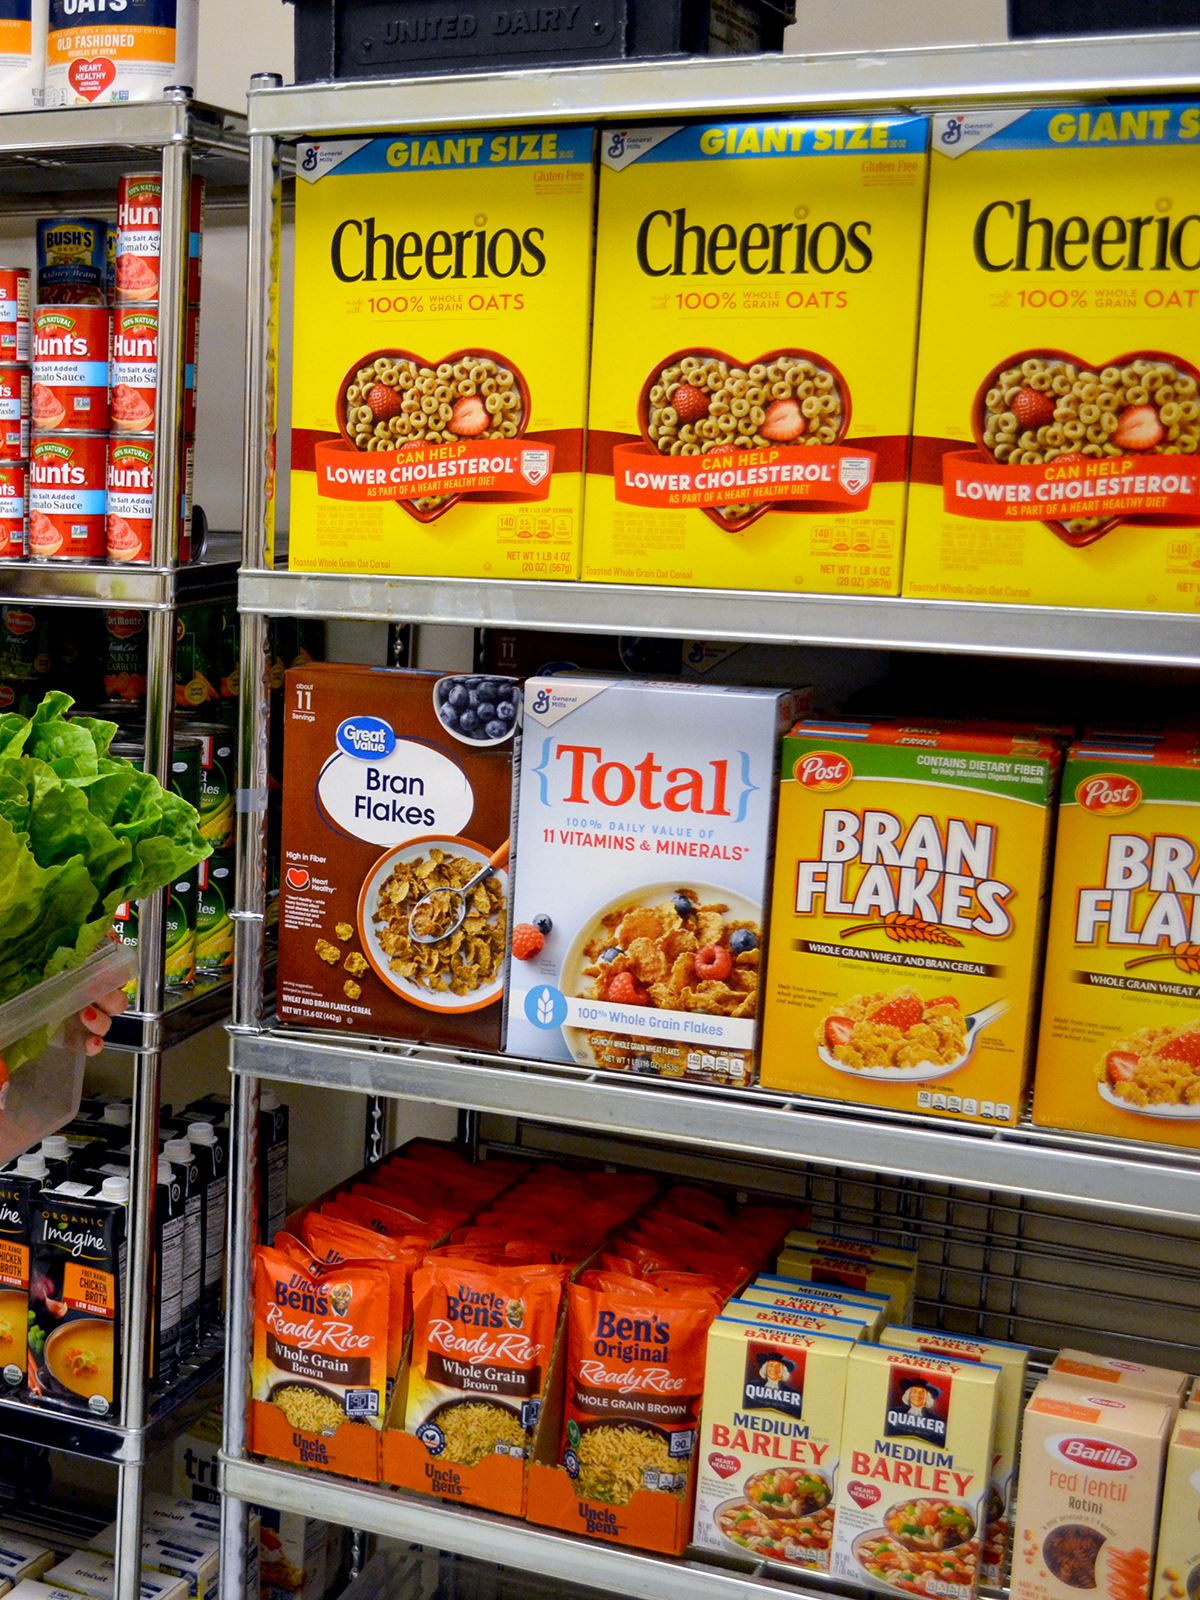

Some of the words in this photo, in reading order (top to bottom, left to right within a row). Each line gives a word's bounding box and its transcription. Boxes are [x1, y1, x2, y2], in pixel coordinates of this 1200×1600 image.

[382, 14, 478, 45] UNITED
[492, 5, 581, 35] DAIRY
[57, 39, 72, 51] OLD
[75, 34, 135, 48] FASHIONED
[75, 72, 106, 81] HEALTHY
[78, 64, 102, 72] HEART
[1048, 110, 1171, 143] GIANT
[700, 127, 808, 155] GIANT
[813, 122, 889, 150] SIZE
[386, 139, 483, 168] GIANT
[490, 134, 557, 162] SIZE
[533, 171, 563, 182] Gluten
[566, 170, 584, 181] Free
[47, 231, 91, 248] BUSH'S
[637, 205, 873, 277] Cheerios
[973, 198, 1200, 272] Cheerio
[331, 214, 546, 283] Cheerios
[676, 293, 736, 310] 100%
[743, 292, 780, 300] WHOLE
[743, 300, 780, 309] GRAIN
[786, 291, 848, 309] OATS
[1018, 290, 1088, 308] 100%
[1095, 299, 1136, 307] GRAIN
[1144, 289, 1200, 308] OAT
[55, 373, 85, 381] Sauce
[326, 466, 386, 484] LOWER
[390, 458, 514, 482] CHOLESTEROL
[702, 456, 733, 471] CAN
[738, 451, 779, 466] HELP
[1044, 467, 1080, 481] CAN
[1085, 461, 1133, 476] HELP
[367, 488, 376, 497] AS
[379, 486, 397, 496] PART
[399, 484, 409, 494] OF
[410, 484, 416, 493] A
[418, 481, 442, 492] HEART
[444, 478, 476, 490] HEALTHY
[478, 476, 495, 486] DIET
[625, 471, 690, 491] LOWER
[694, 465, 831, 489] CHOLESTEROL
[956, 480, 1031, 502] LOWER
[1036, 476, 1192, 501] CHOLESTEROL
[54, 502, 83, 510] Sauce
[297, 690, 312, 710] 11
[344, 725, 386, 742] Great
[353, 740, 386, 753] Value
[802, 757, 844, 781] Post
[917, 755, 967, 769] CONTAINS
[969, 760, 1012, 773] DIETARY
[1014, 764, 1044, 776] FIBER
[366, 768, 425, 796] Bran
[556, 744, 731, 816] Total
[1085, 781, 1132, 805] Post
[355, 795, 435, 827] Flakes
[566, 817, 602, 829] 100%
[609, 821, 645, 833] DAILY
[652, 826, 692, 837] VALUE
[700, 830, 714, 839] OF
[544, 829, 554, 843] 11
[560, 831, 634, 851] VITAMINS
[640, 840, 651, 851] &
[656, 840, 742, 860] MINERALS
[822, 810, 993, 879] BRAN
[286, 851, 301, 862] High
[310, 854, 326, 864] Fiber
[312, 877, 328, 886] Heart
[796, 861, 1014, 935] FLAKES
[808, 943, 839, 956] WHOLE
[841, 947, 867, 959] GRAIN
[869, 950, 903, 963] WHEAT
[905, 955, 924, 965] AND
[925, 957, 951, 969] BRAN
[952, 961, 985, 974] CEREAL
[1089, 974, 1124, 988] WHOLE
[1127, 978, 1157, 992] GRAIN
[1159, 982, 1194, 996] WHEAT
[42, 1210, 104, 1228] ORGANIC
[42, 1220, 104, 1257] Imagine
[4, 1275, 22, 1286] SODIUM
[79, 1278, 107, 1294] CHICKEN
[459, 1284, 504, 1310] Uncle
[773, 1299, 843, 1316] BARLEY
[267, 1302, 323, 1349] Ready
[322, 1321, 370, 1352] Rice
[596, 1311, 670, 1343] Ben's
[275, 1342, 309, 1363] Whole
[311, 1354, 349, 1372] Grain
[594, 1340, 668, 1363] Original
[292, 1363, 323, 1378] Brown
[442, 1359, 481, 1378] Whole
[484, 1369, 526, 1384] Grain
[579, 1360, 642, 1394] Ready
[640, 1368, 683, 1392] Rice
[577, 1393, 608, 1407] WHOLE
[611, 1398, 645, 1412] GRAIN
[647, 1403, 687, 1415] BROWN
[745, 1384, 800, 1406] QUAKER
[733, 1412, 809, 1439] MEDIUM
[888, 1410, 945, 1434] QUAKER
[293, 1433, 327, 1454] Uncle
[711, 1424, 830, 1466] BARLEY
[874, 1440, 953, 1469] MEDIUM
[1065, 1442, 1132, 1467] Barilla
[851, 1451, 974, 1496] BARLEY
[1049, 1470, 1078, 1491] red
[1083, 1473, 1127, 1502] lentil
[1068, 1496, 1103, 1515] Rotini
